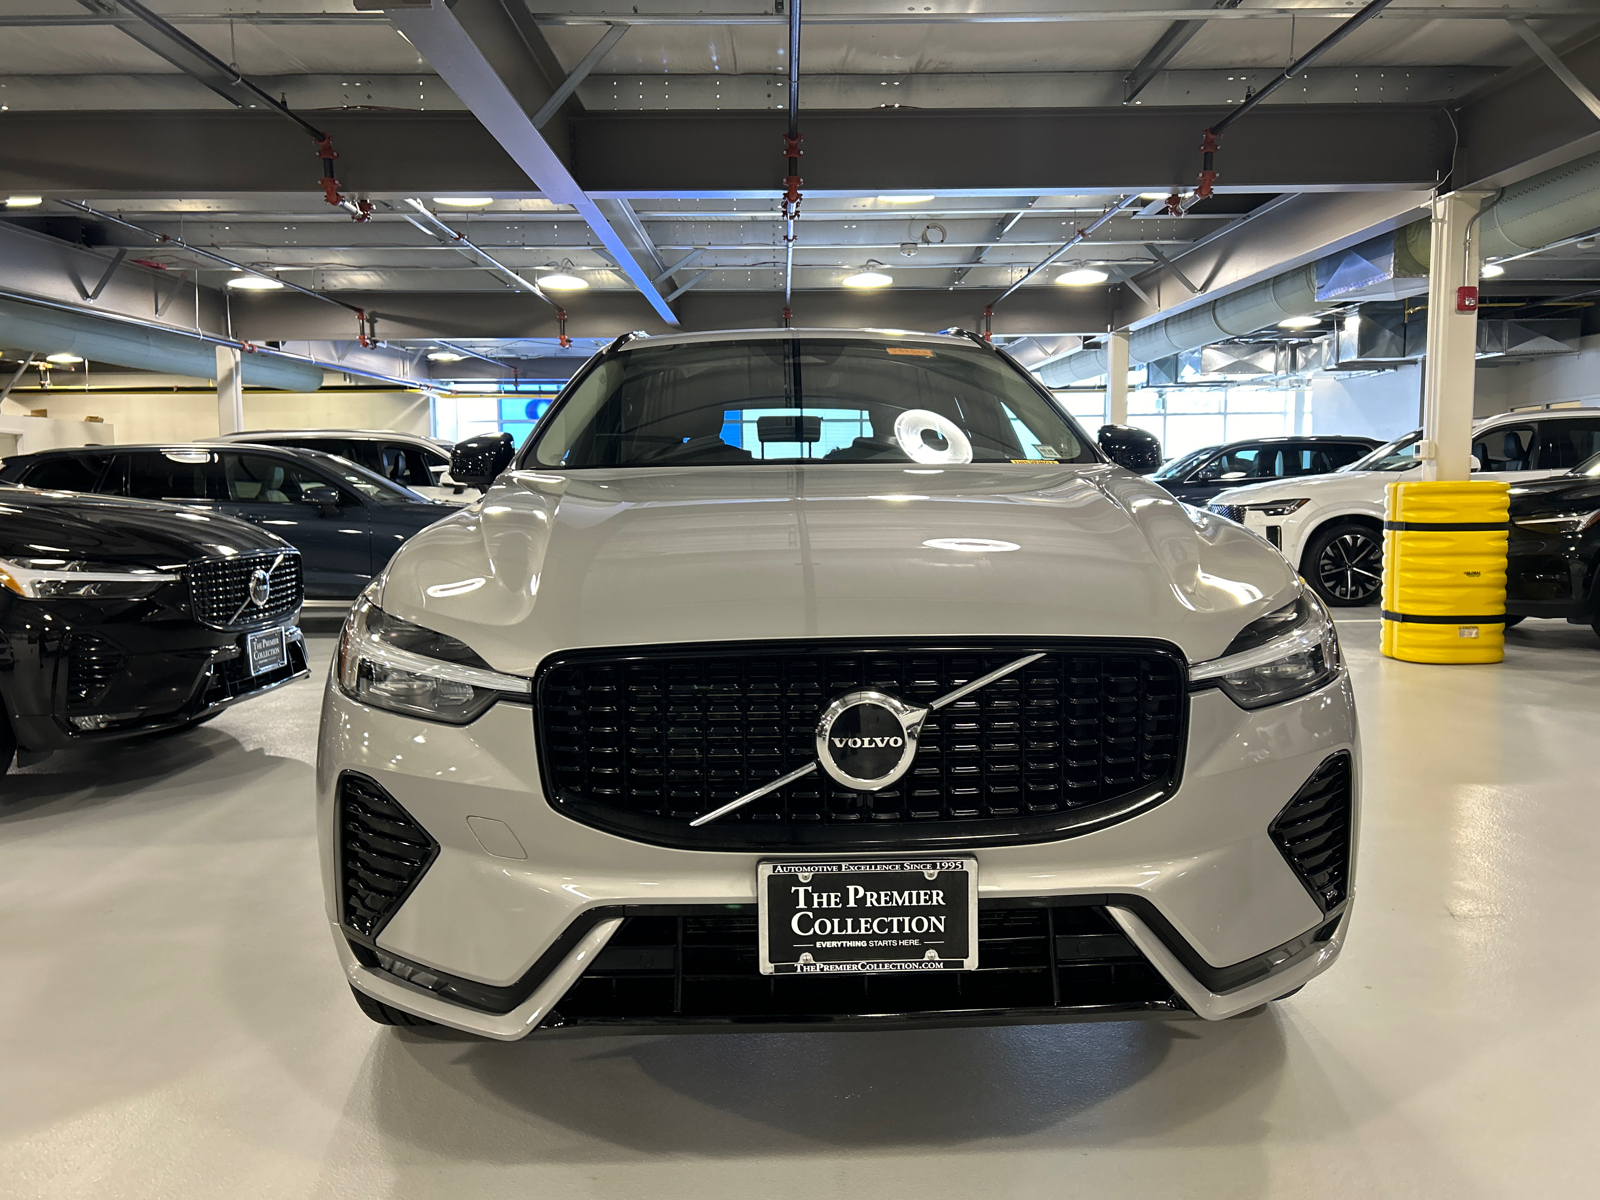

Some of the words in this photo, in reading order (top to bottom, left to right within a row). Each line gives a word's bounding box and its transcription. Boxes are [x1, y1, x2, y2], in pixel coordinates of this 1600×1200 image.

[253, 641, 262, 651] THE
[262, 638, 279, 648] PREMIER
[254, 647, 280, 661] COLLECTION
[831, 736, 903, 748] VOLVO
[774, 864, 839, 873] AUTOMOTIVE
[841, 862, 901, 872] EXCELLENCE
[903, 862, 932, 871] SINCE
[935, 861, 962, 870] 1995
[791, 886, 842, 909] THE
[846, 885, 946, 908] PREMIER
[790, 911, 946, 936] COLLECTION
[816, 940, 867, 948] EVERYTHING
